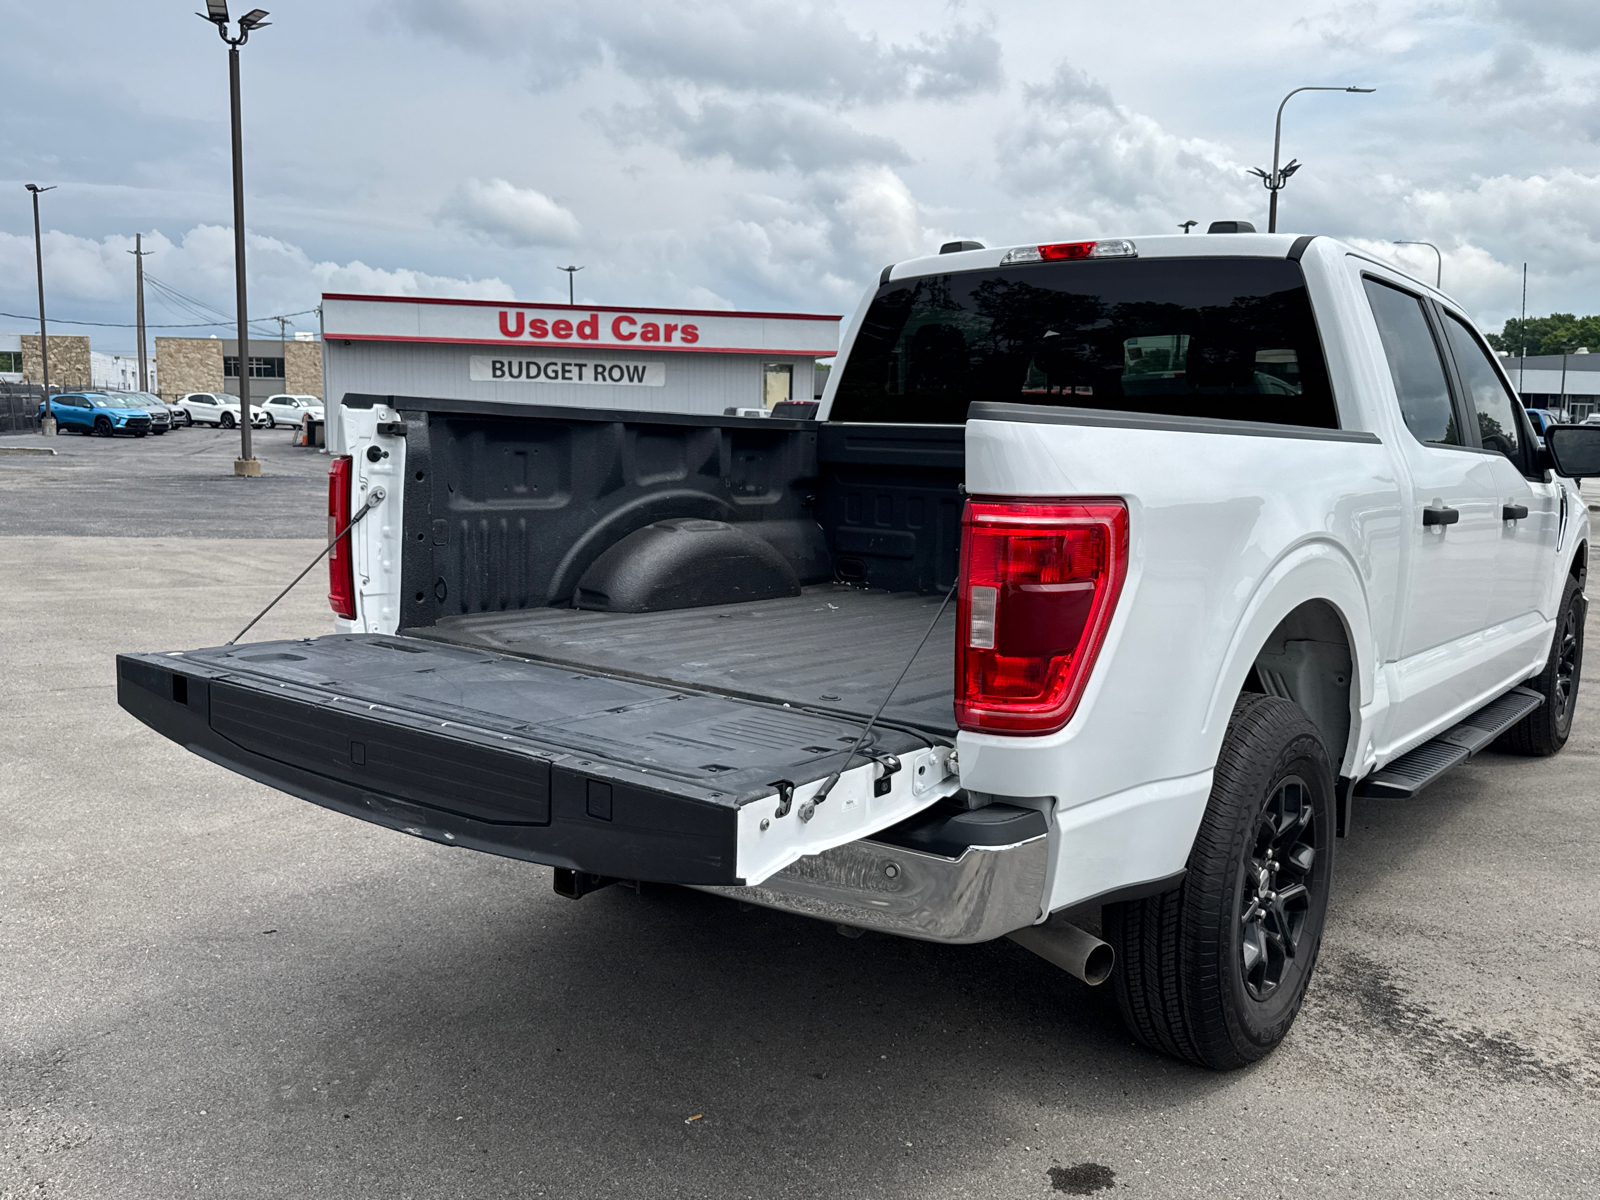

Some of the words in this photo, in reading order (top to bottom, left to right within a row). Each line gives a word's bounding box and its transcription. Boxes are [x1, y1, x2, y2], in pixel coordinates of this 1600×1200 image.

[499, 311, 599, 339] Used
[611, 315, 699, 343] Cars
[491, 360, 588, 381] BUDGET
[593, 364, 647, 384] ROW
